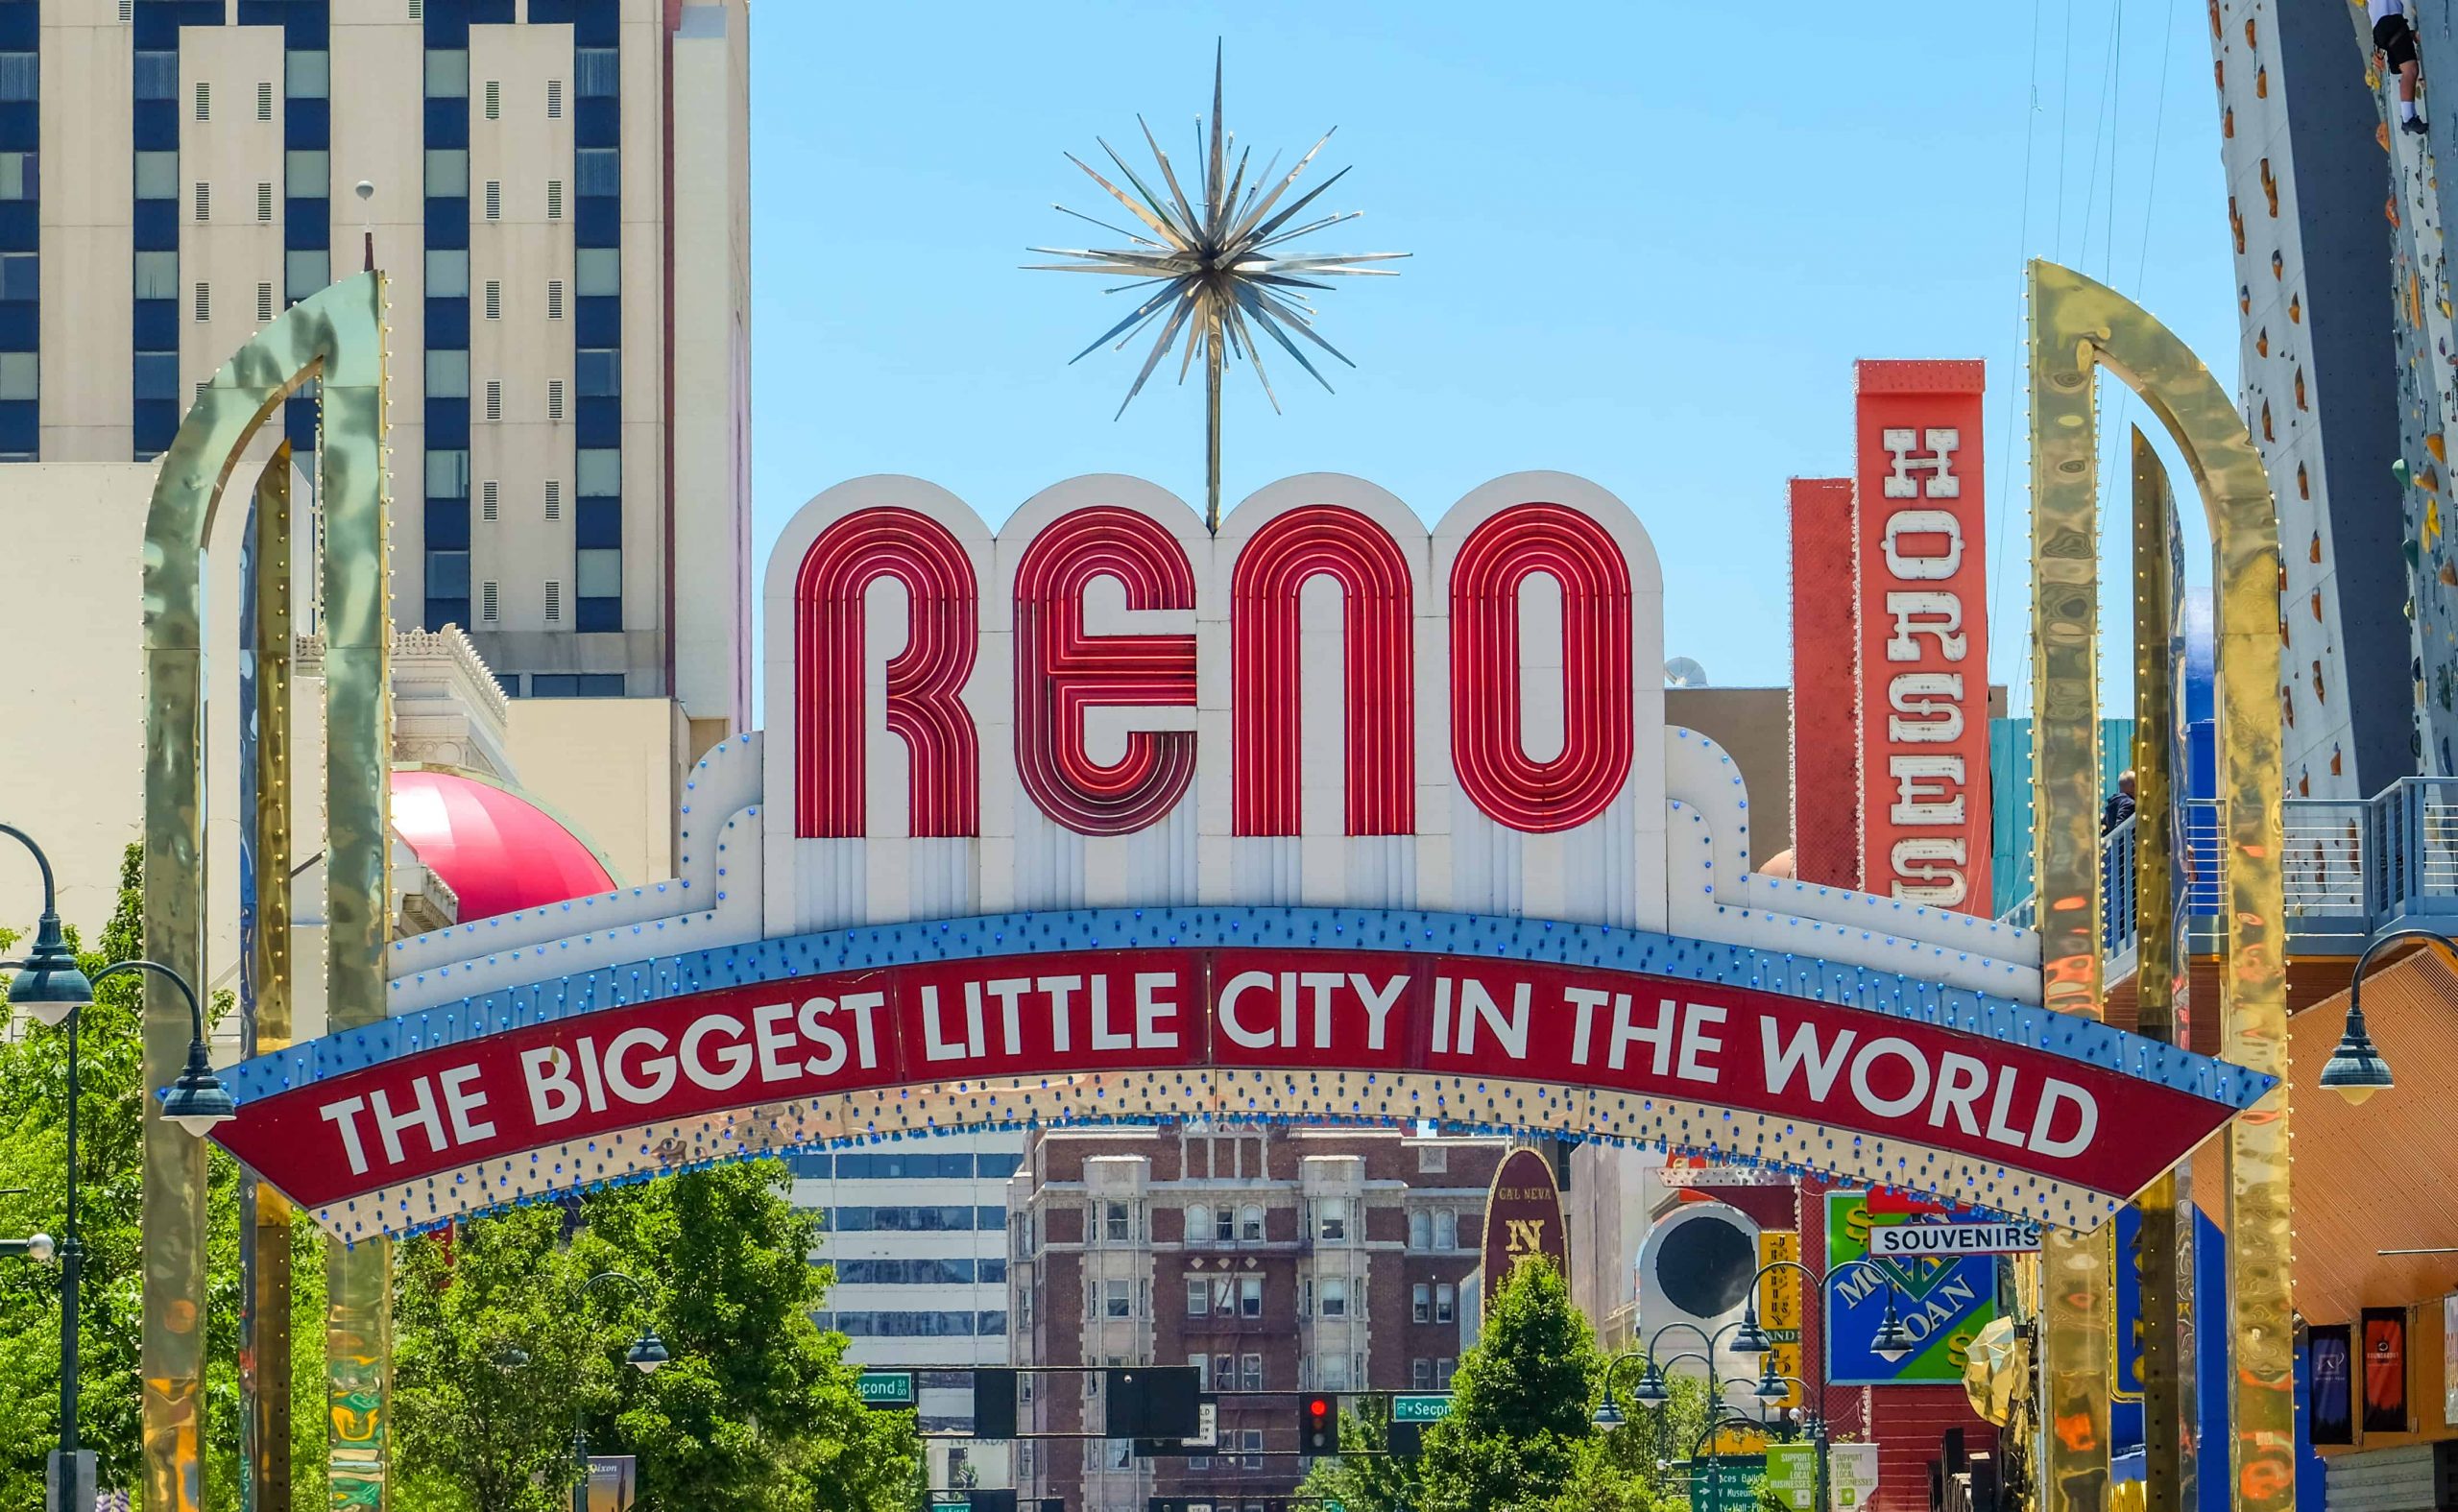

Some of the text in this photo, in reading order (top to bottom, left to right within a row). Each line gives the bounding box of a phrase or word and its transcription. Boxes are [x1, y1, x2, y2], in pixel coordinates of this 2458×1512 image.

[795, 502, 1633, 838] RENO
[1880, 428, 1966, 910] HORSES
[320, 971, 2098, 1175] THE BIGGEST LITTLE CITY IN THE WORLD
[1499, 1188, 1552, 1200] CAL NEVA
[1884, 1227, 2039, 1251] SOUVENIRS
[1900, 1273, 1976, 1342] OAN
[1766, 1331, 1795, 1341] AND
[1415, 1403, 1452, 1416] Secon
[1781, 1453, 1811, 1462] SUPPORT
[1836, 1453, 1863, 1462] SUPPORT
[1793, 1462, 1811, 1471] YOUR
[1836, 1462, 1852, 1471] YOUR
[1790, 1471, 1811, 1479] LOCAL
[1771, 1479, 1812, 1489] BUSINESSES
[1836, 1478, 1873, 1487] BUSINESSES
[1727, 1488, 1753, 1498] Museum
